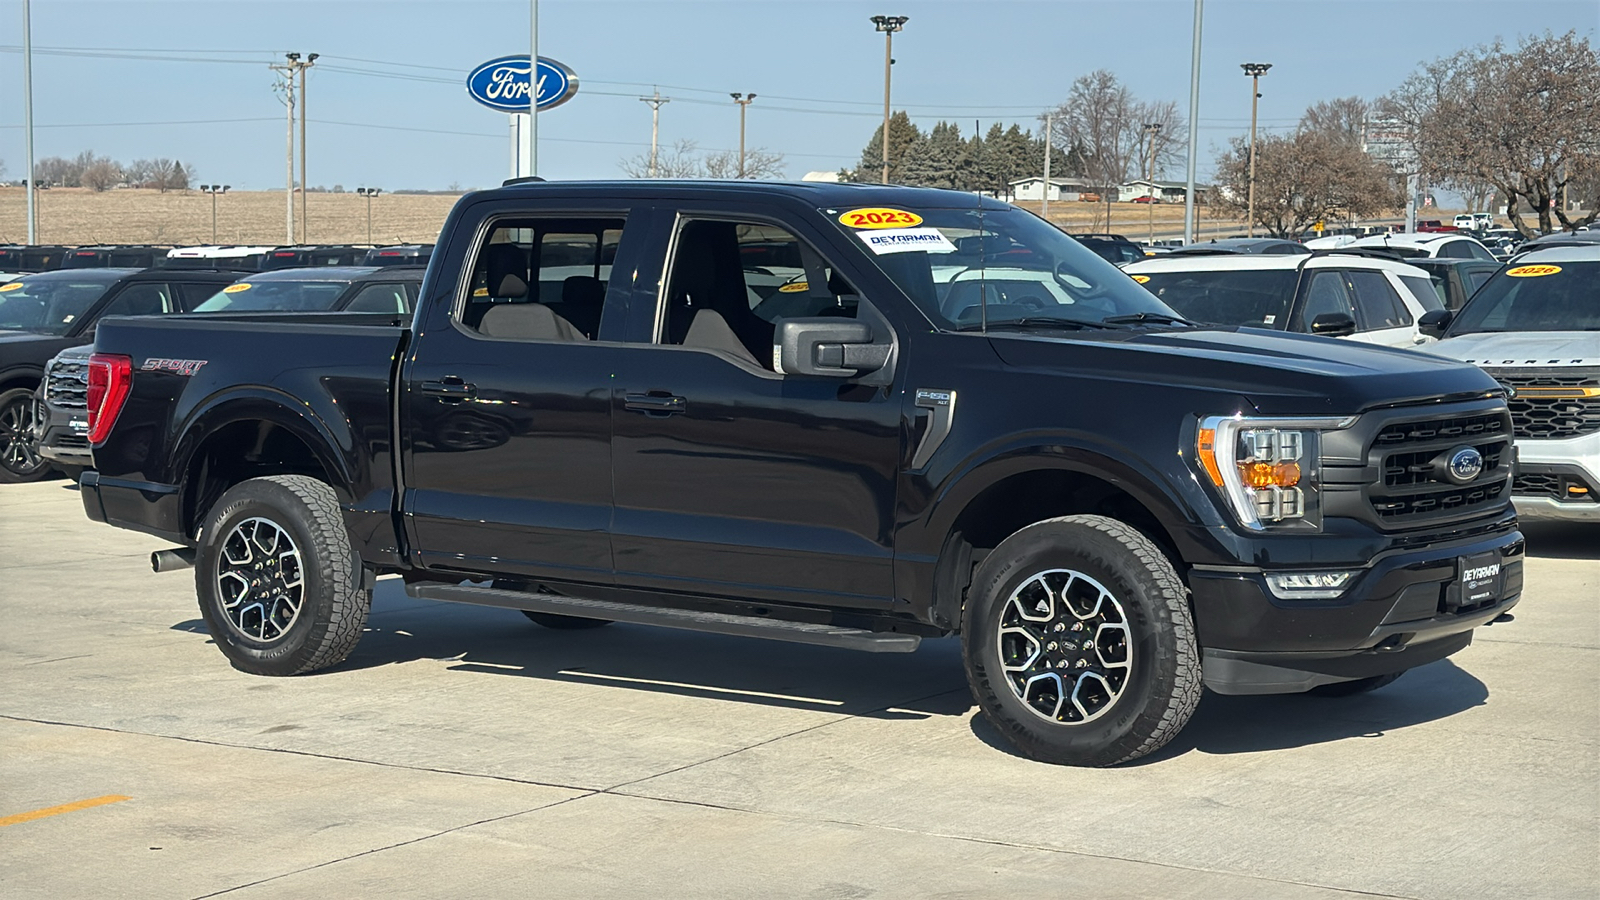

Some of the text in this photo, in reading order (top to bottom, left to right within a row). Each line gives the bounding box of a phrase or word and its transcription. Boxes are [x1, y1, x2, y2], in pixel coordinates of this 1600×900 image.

[486, 66, 547, 99] Ford
[851, 212, 915, 225] 2023
[870, 235, 941, 244] DEYARMAN
[1511, 267, 1556, 275] 2026
[141, 357, 208, 371] SPORT
[918, 391, 949, 400] F-150
[1463, 563, 1500, 581] DEYARMAN
